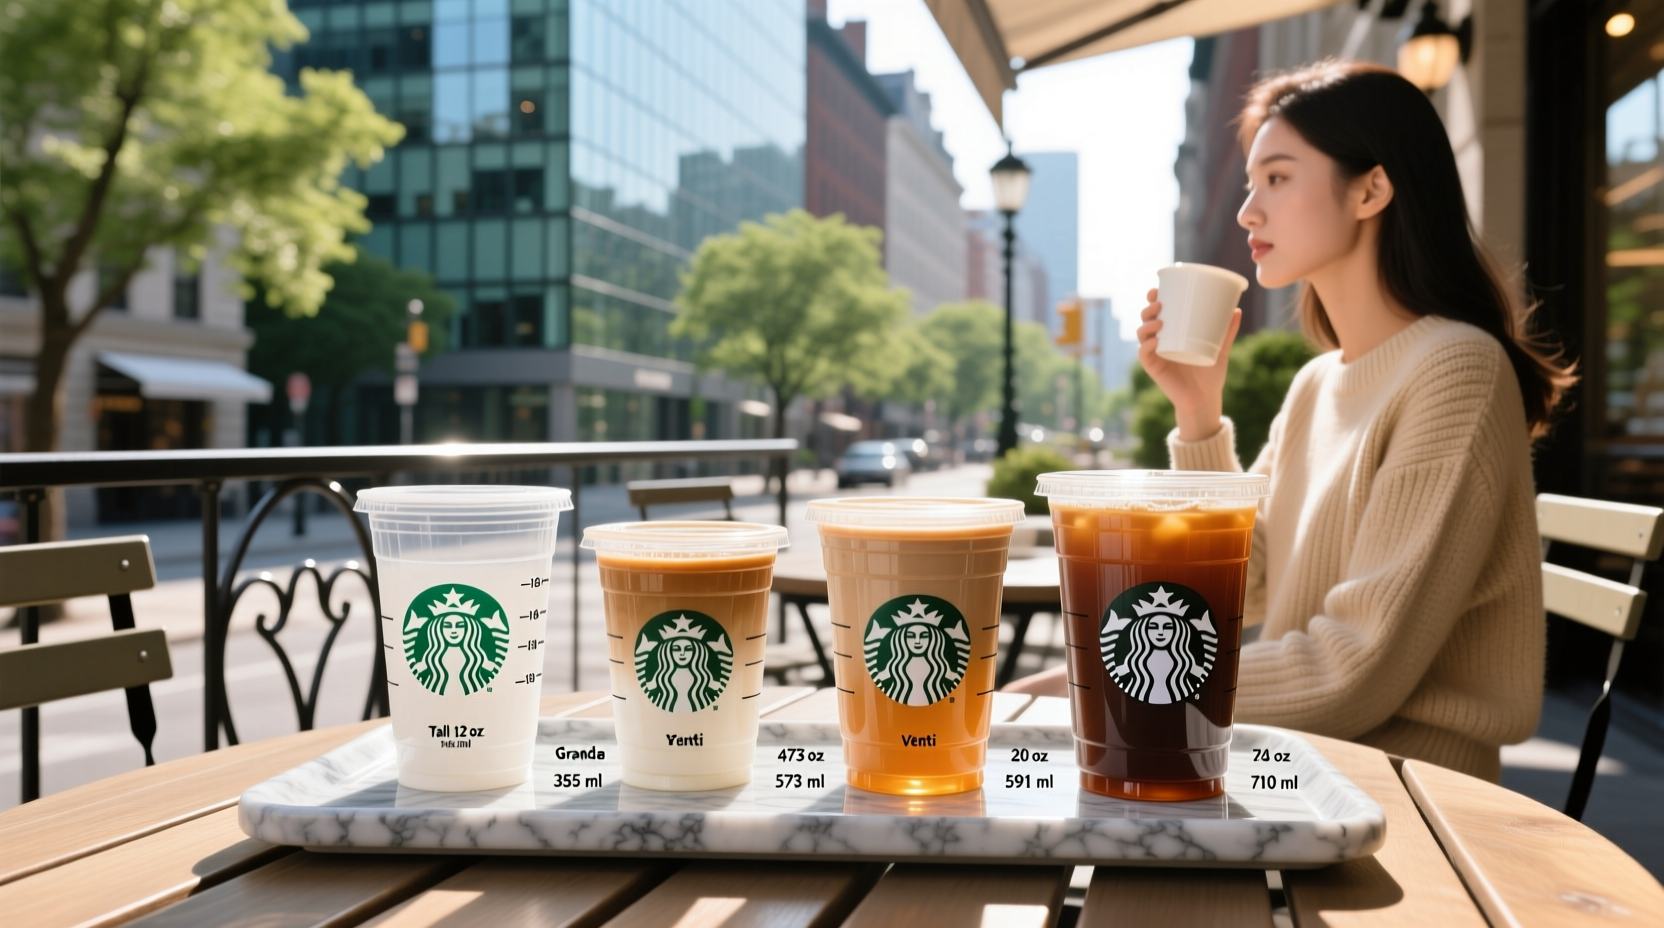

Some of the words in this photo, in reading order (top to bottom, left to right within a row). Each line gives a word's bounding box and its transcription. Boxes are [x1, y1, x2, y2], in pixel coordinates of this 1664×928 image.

[428, 724, 450, 738] Tall
[454, 725, 468, 738] 12
[469, 727, 486, 738] oz
[901, 733, 937, 747] Venti
